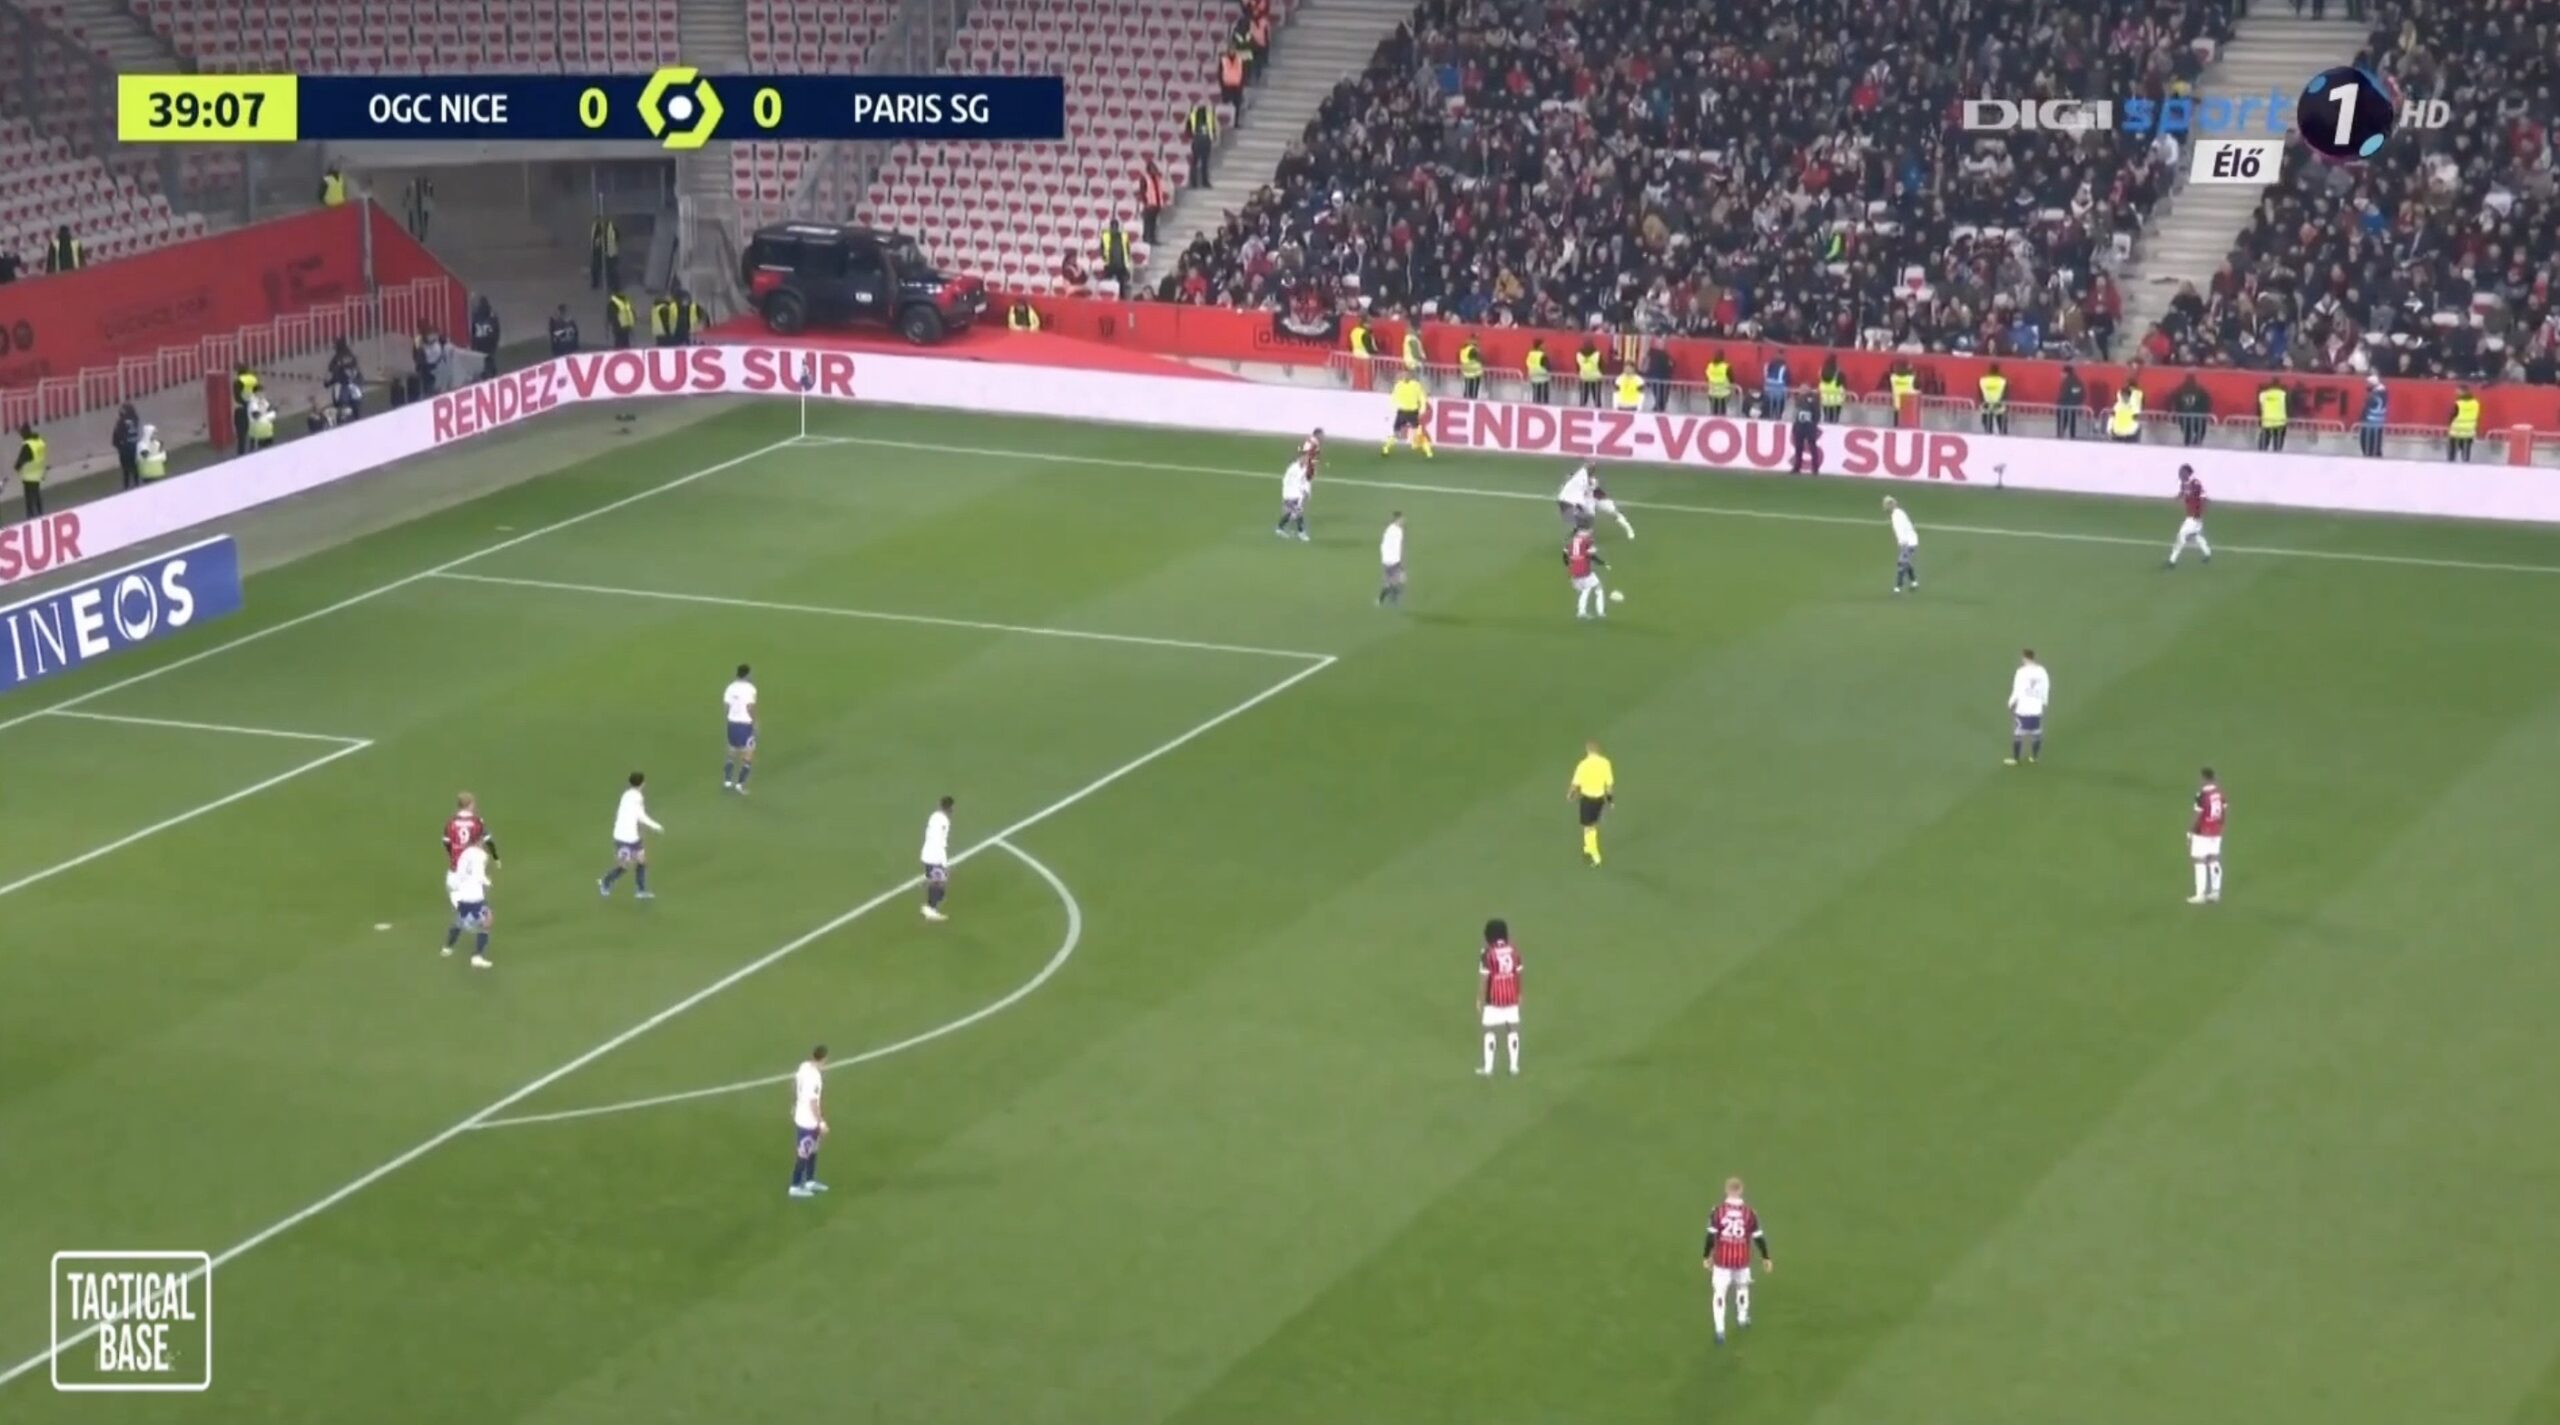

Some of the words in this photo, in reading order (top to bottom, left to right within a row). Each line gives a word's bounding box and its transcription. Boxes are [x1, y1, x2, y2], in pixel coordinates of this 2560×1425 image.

[433, 349, 727, 442] RENDEZ-VOUS
[742, 348, 856, 397] SUR
[1842, 428, 1968, 481] SUR
[0, 511, 83, 581] SUR
[7, 559, 194, 682] INEOS
[1720, 1217, 1745, 1238] 26
